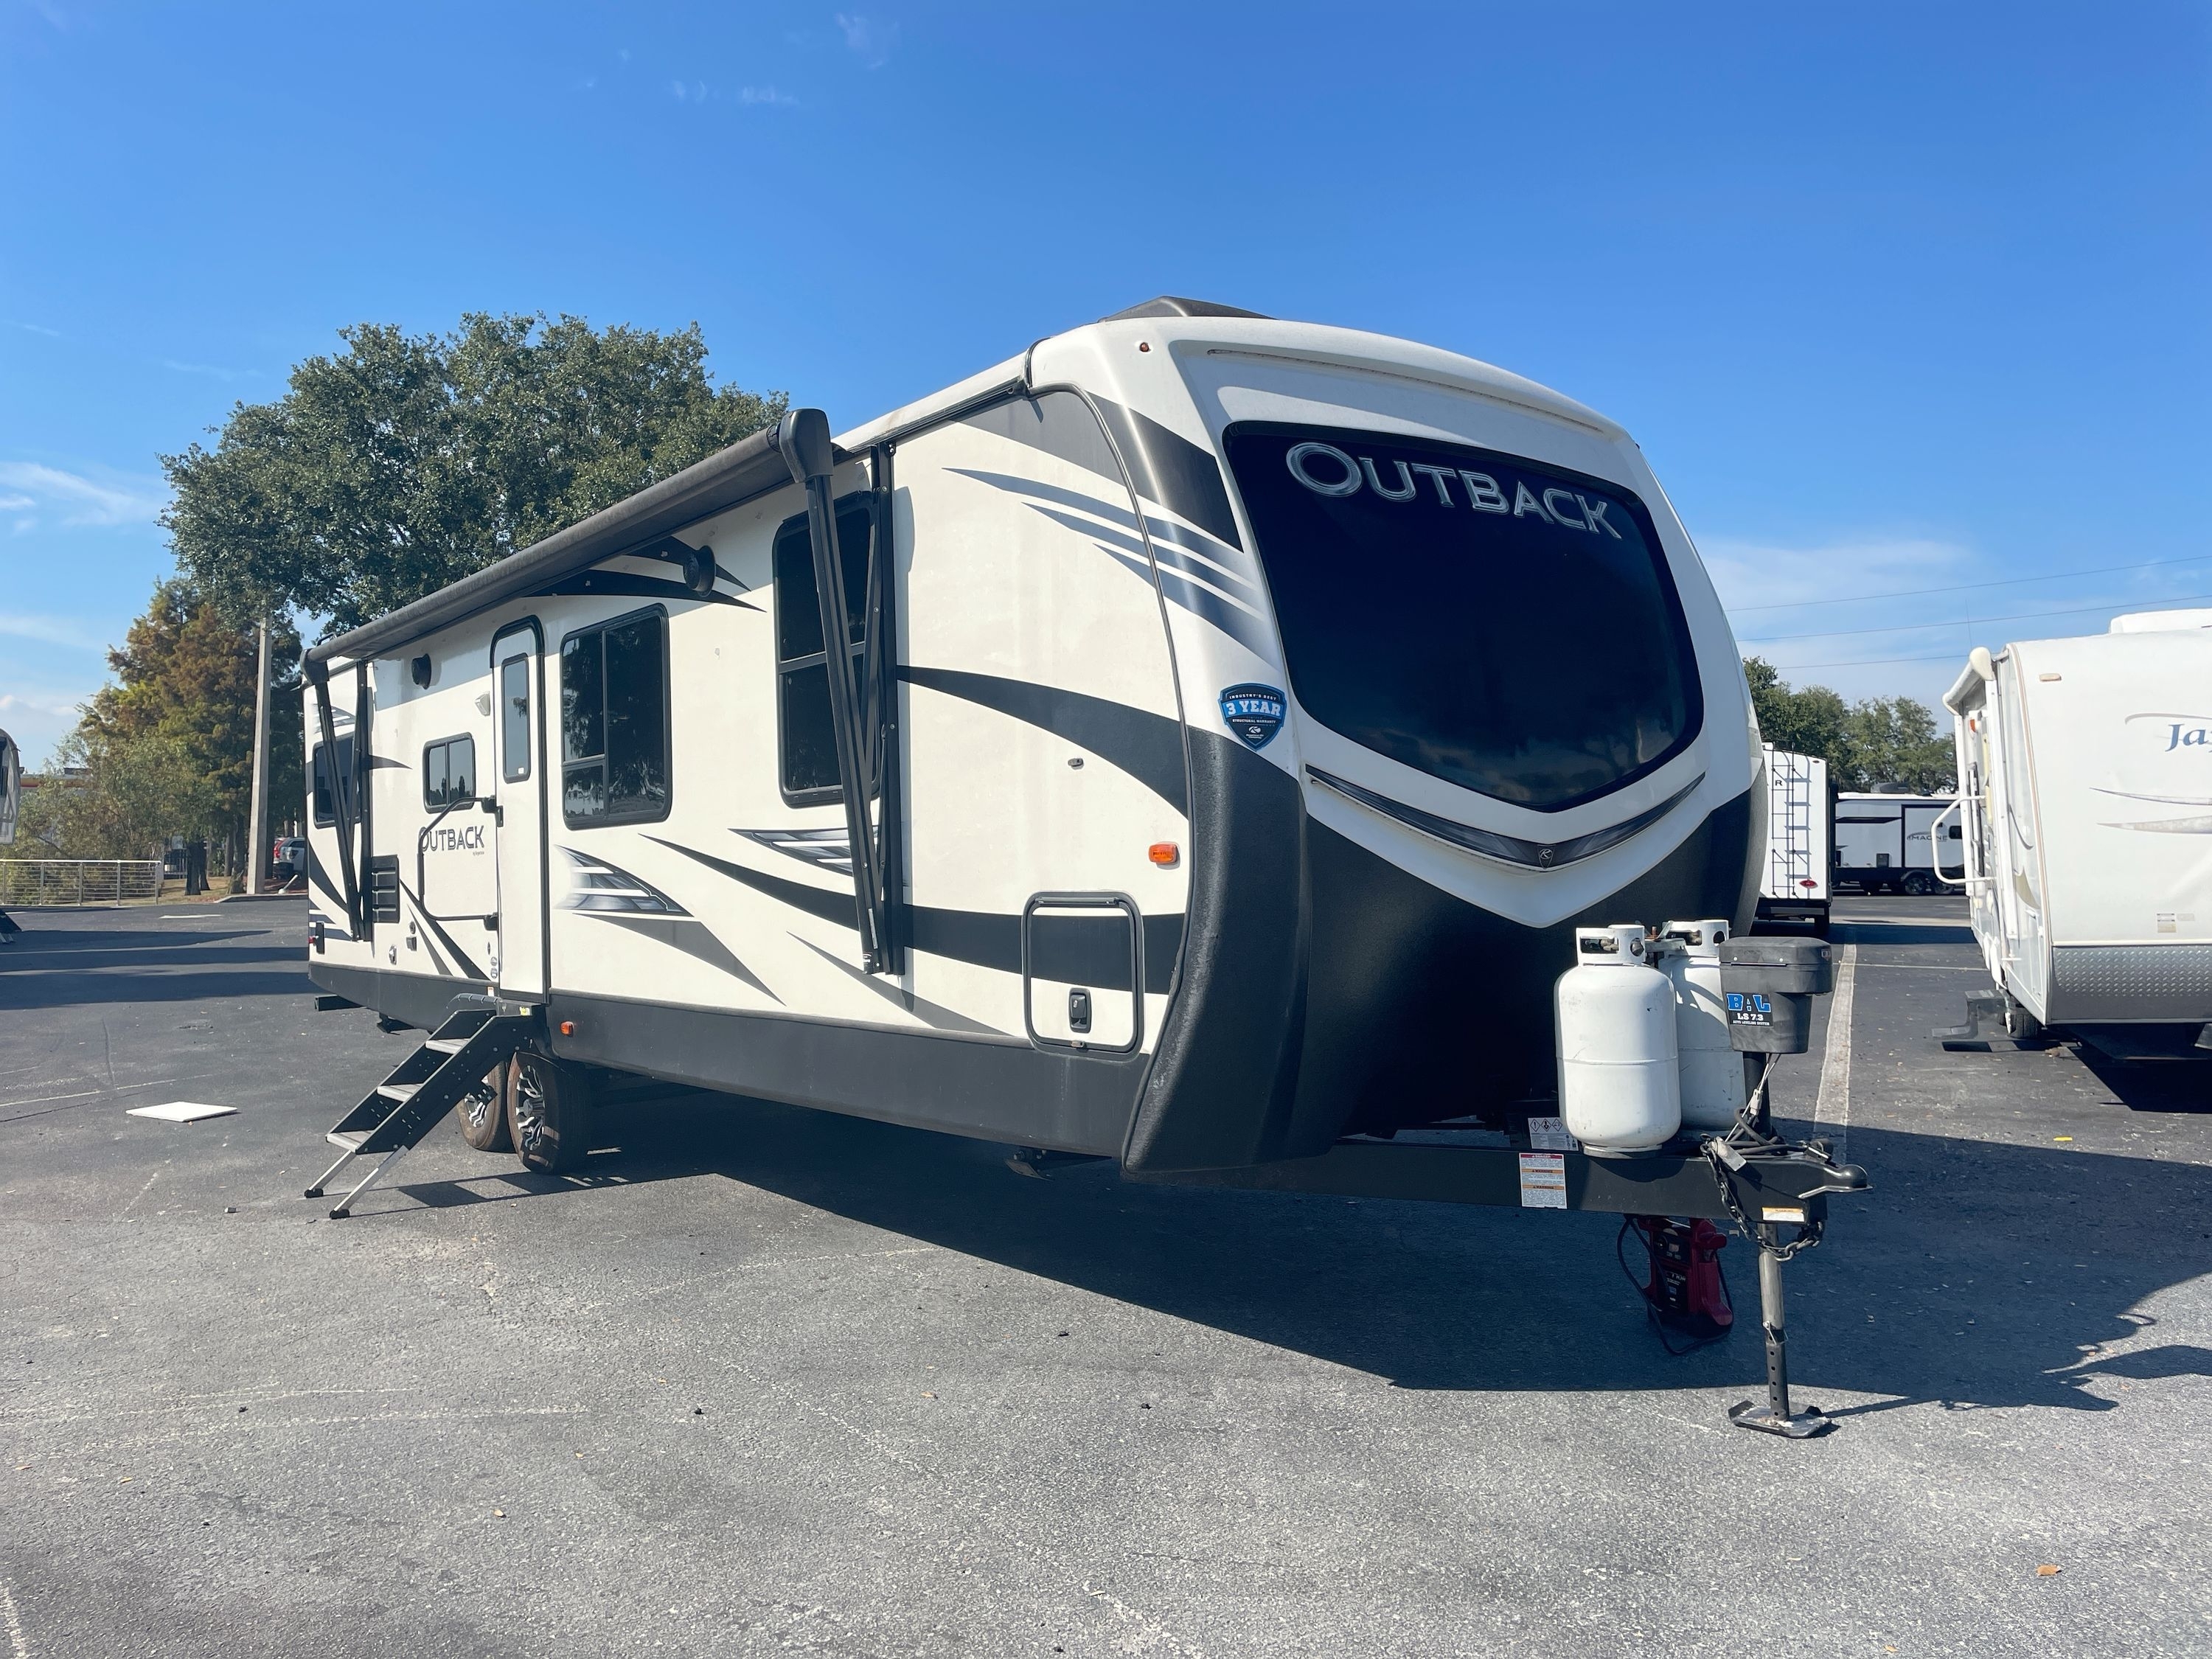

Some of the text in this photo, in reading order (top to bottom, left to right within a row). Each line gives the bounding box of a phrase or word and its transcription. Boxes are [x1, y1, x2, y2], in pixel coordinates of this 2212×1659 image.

[1286, 442, 1622, 540] OUTBACK
[1225, 700, 1281, 717] 3 YEAR
[2165, 723, 2212, 753] Ja
[418, 825, 485, 852] OUTBACK
[1726, 993, 1772, 1013] BAL
[1736, 1012, 1750, 1020] LS
